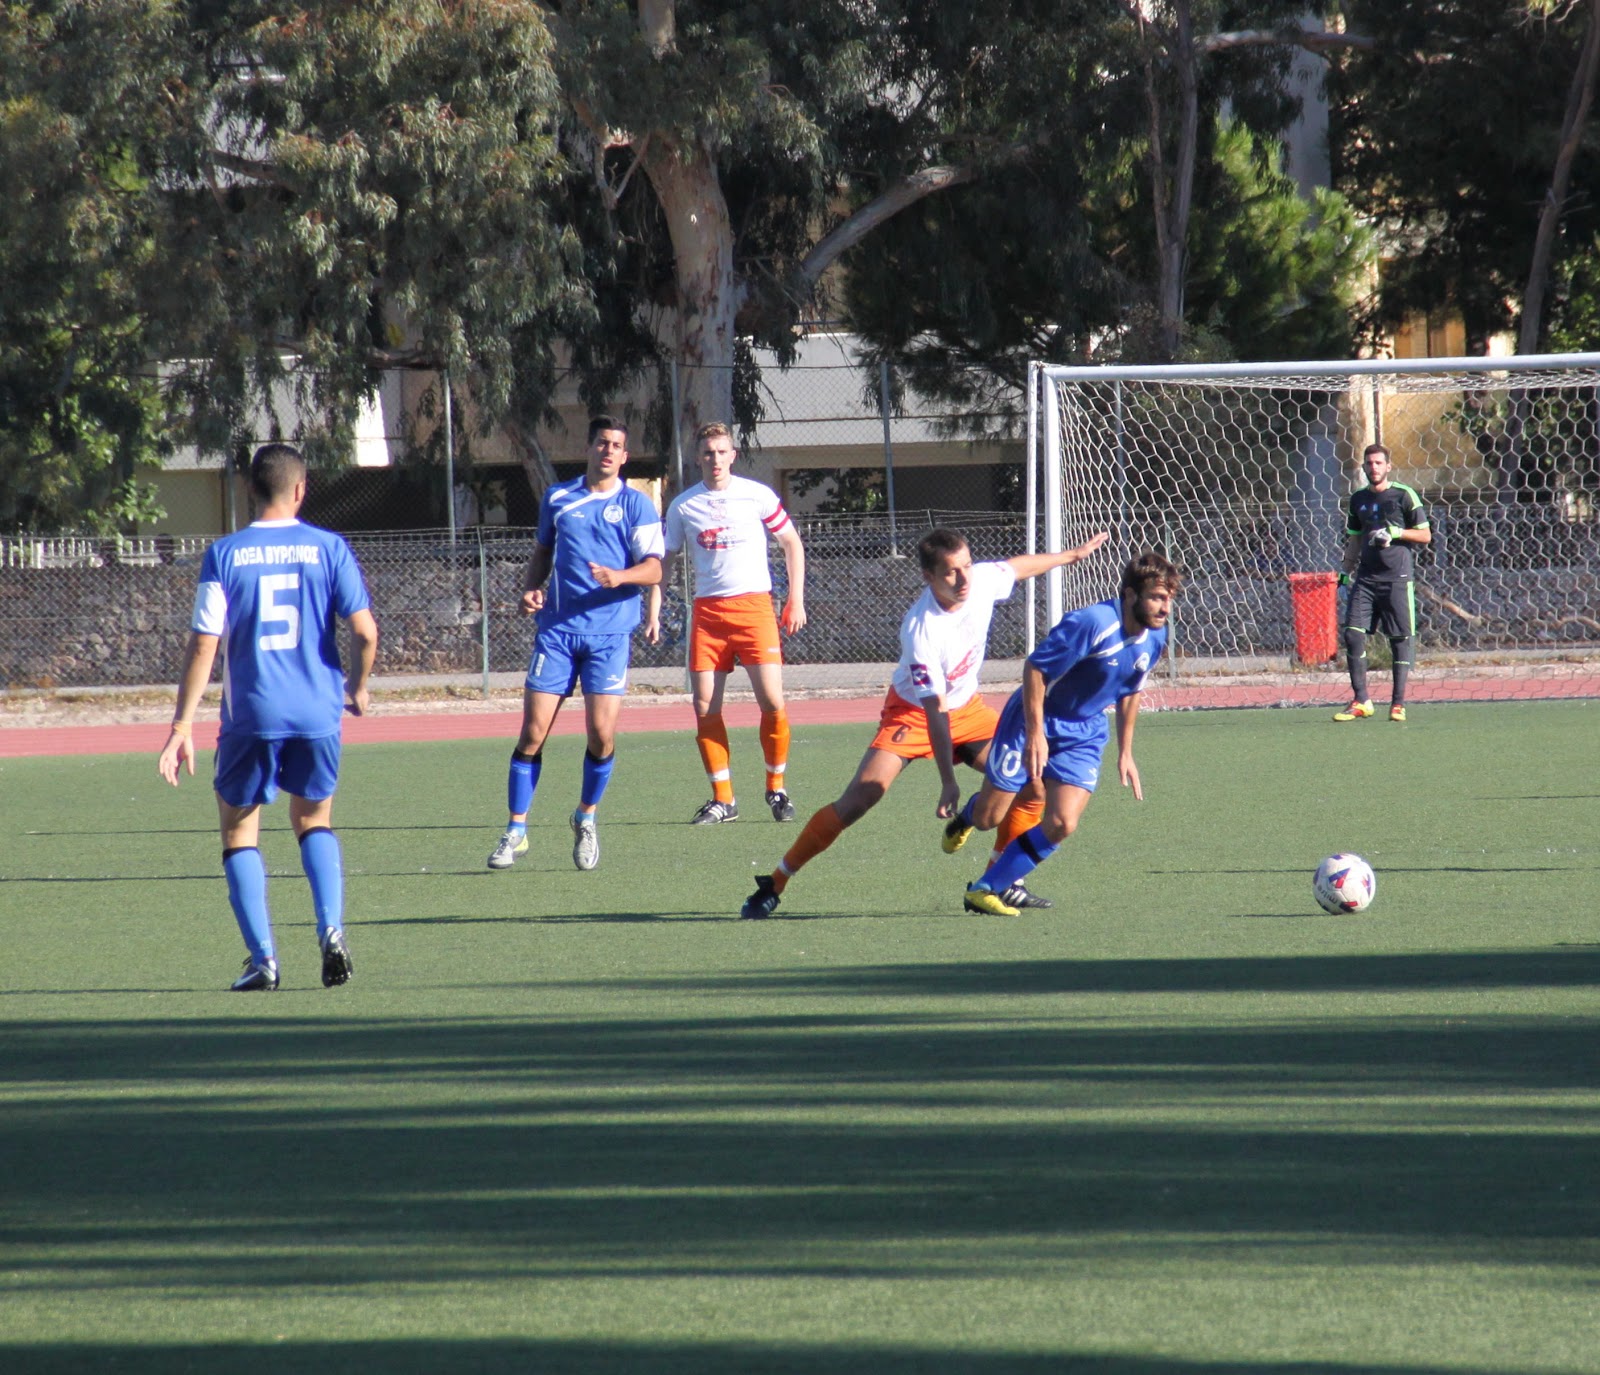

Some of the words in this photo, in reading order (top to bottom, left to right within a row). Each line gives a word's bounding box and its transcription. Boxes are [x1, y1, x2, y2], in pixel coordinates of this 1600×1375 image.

[234, 546, 264, 566] ΔΟΞΑ
[259, 573, 299, 651] 5
[891, 724, 912, 743] 6
